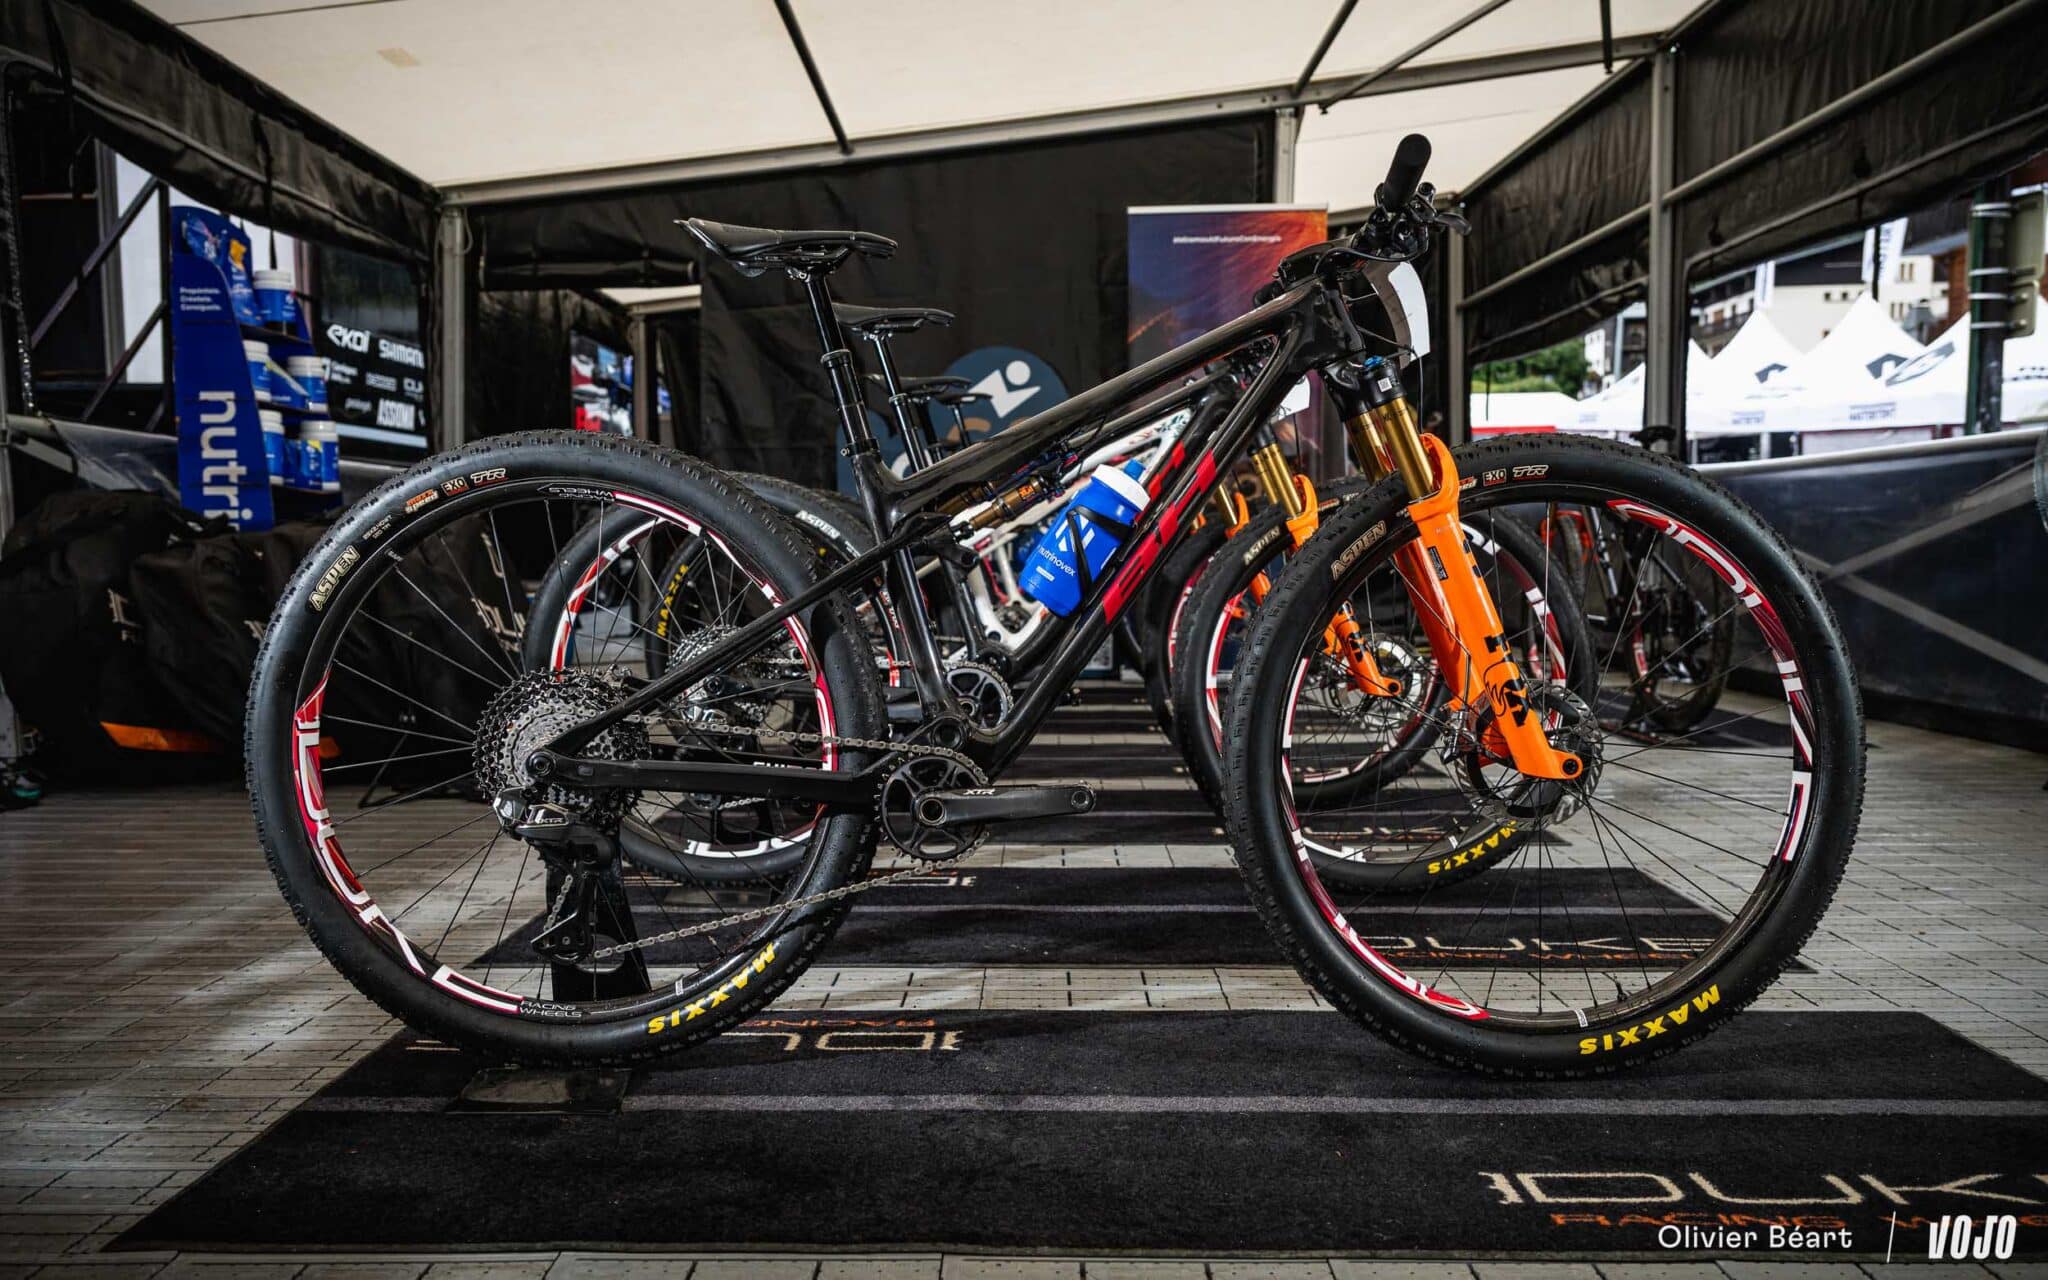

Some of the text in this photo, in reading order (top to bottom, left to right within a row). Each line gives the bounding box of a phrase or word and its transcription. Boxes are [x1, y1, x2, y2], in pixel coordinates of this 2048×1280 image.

[199, 391, 253, 529] nutri
[1038, 546, 1076, 577] nutrinovex
[1243, 525, 1281, 566] ASPEN
[1330, 520, 1388, 581] ASPEN
[309, 545, 361, 612] ASPEN
[963, 788, 996, 796] XTR
[520, 1000, 577, 1012] RACING
[520, 1007, 582, 1019] WHEELS
[648, 943, 776, 1034] MAXXIS
[1579, 984, 1721, 1056] MAXXIS
